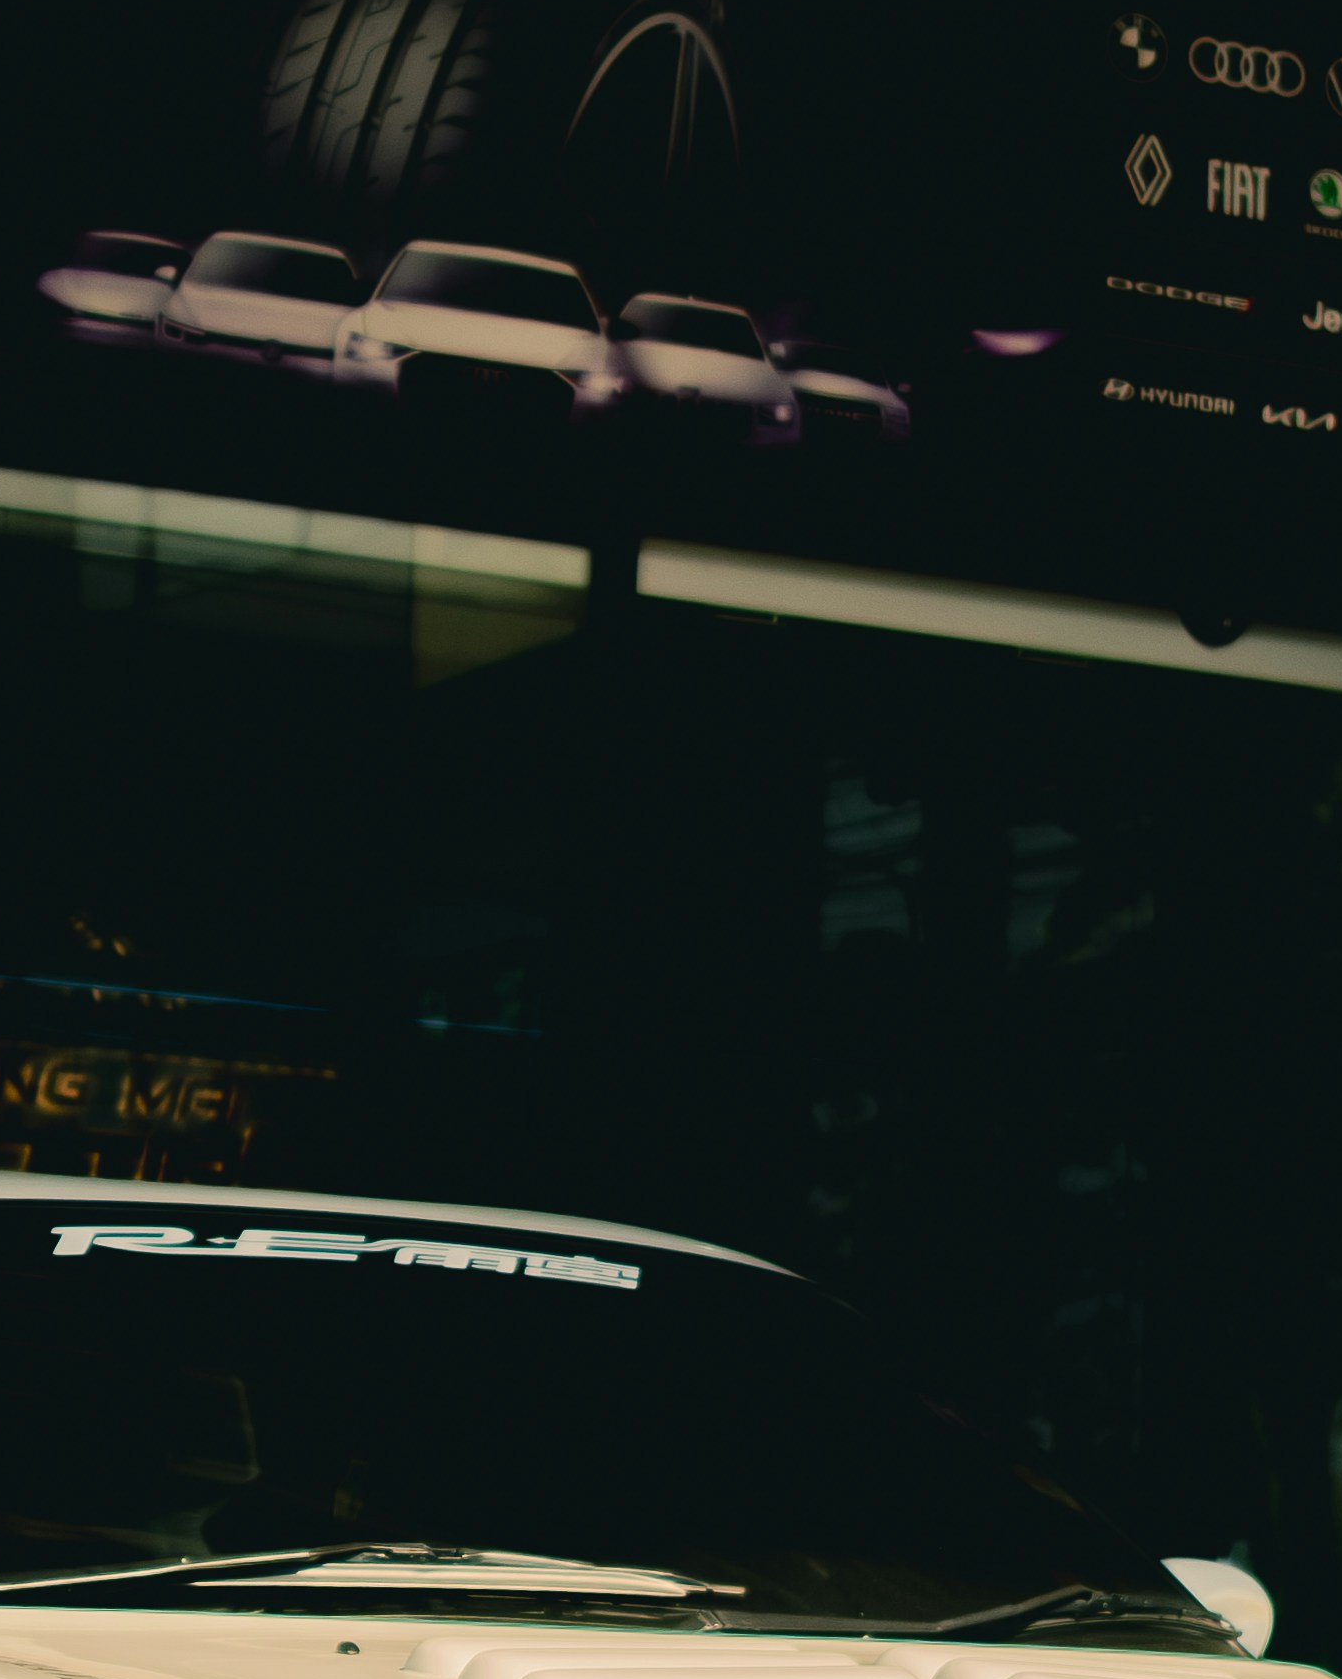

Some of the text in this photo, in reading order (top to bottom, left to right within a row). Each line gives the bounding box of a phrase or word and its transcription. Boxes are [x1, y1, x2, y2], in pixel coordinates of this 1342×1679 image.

[1207, 158, 1272, 221] FIAT
[1106, 275, 1250, 312] DODGE
[1140, 386, 1236, 416] HYUNDAI
